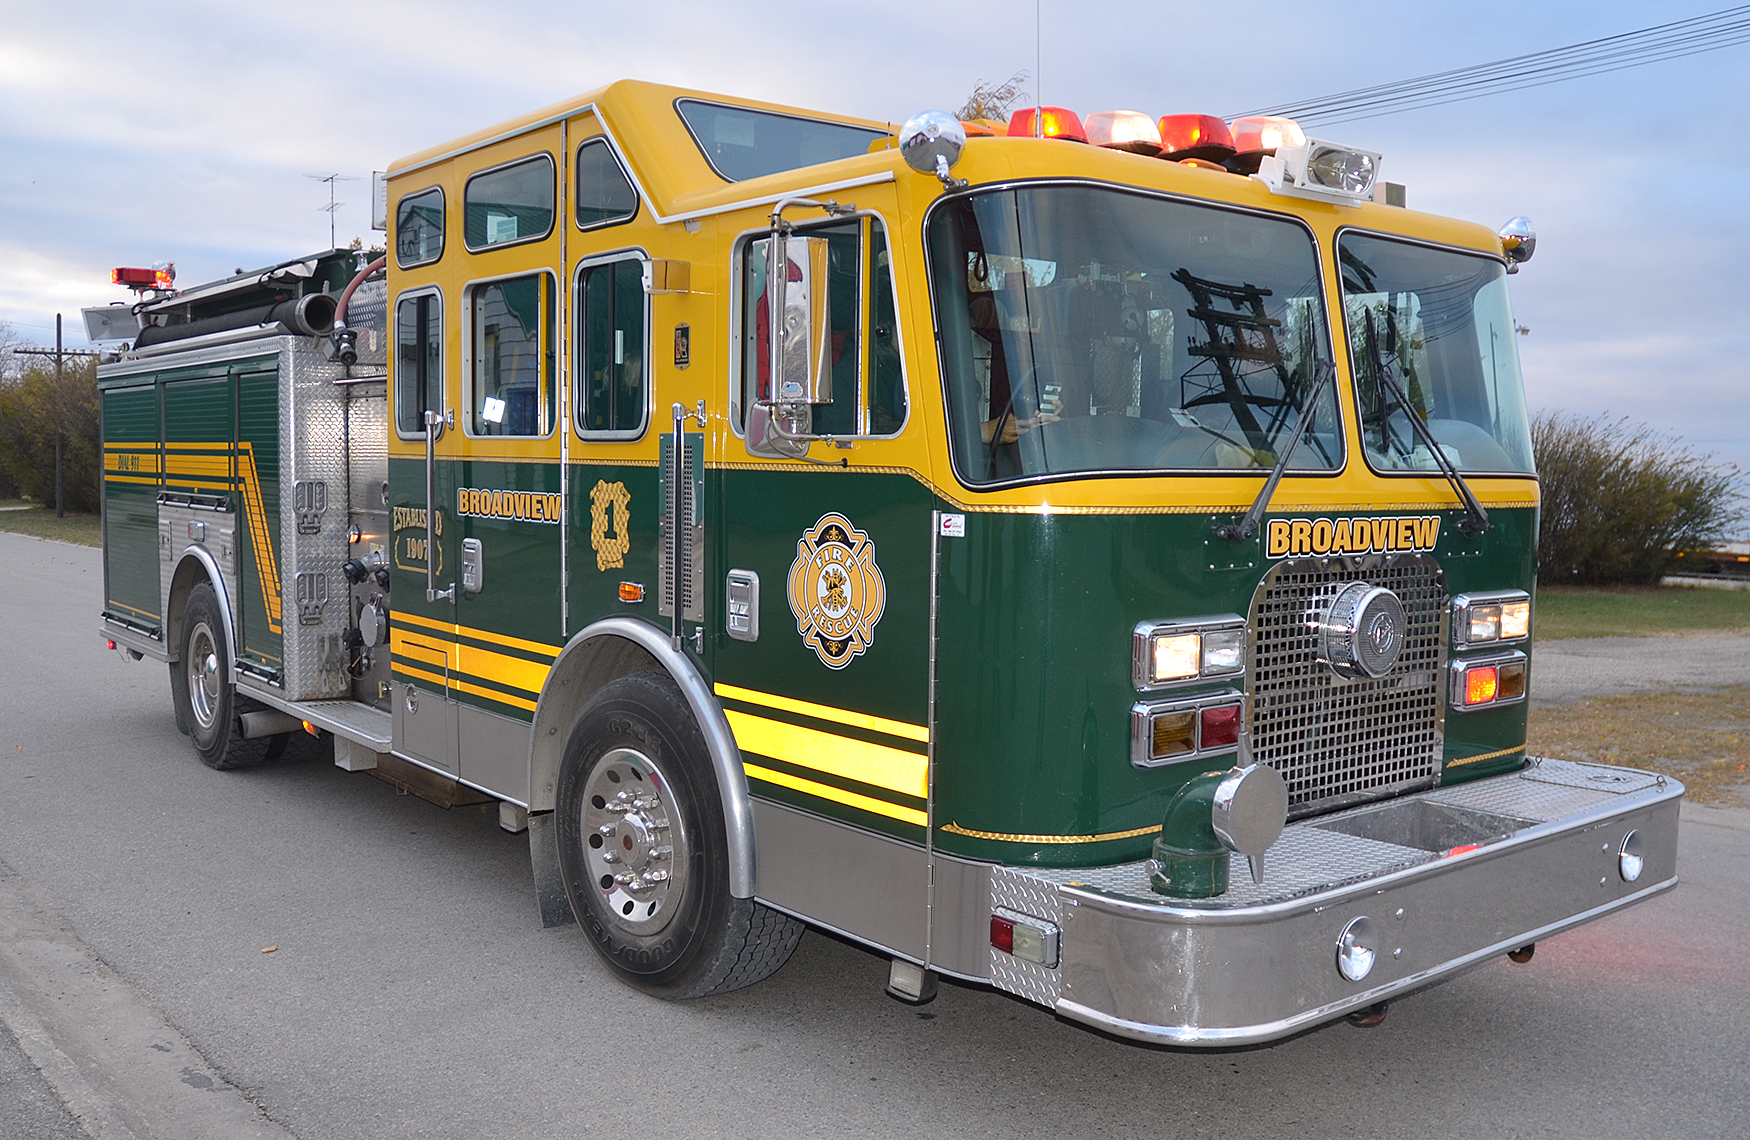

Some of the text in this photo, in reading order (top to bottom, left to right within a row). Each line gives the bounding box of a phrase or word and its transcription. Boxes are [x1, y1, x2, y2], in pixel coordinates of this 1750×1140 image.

[393, 506, 443, 536] ESTABLISD
[457, 488, 561, 524] BROADVIEW
[1267, 516, 1441, 559] BROADVIEW
[815, 547, 855, 572] FIRE
[812, 604, 859, 634] RESCUE
[573, 881, 677, 963] GOODYEAR
